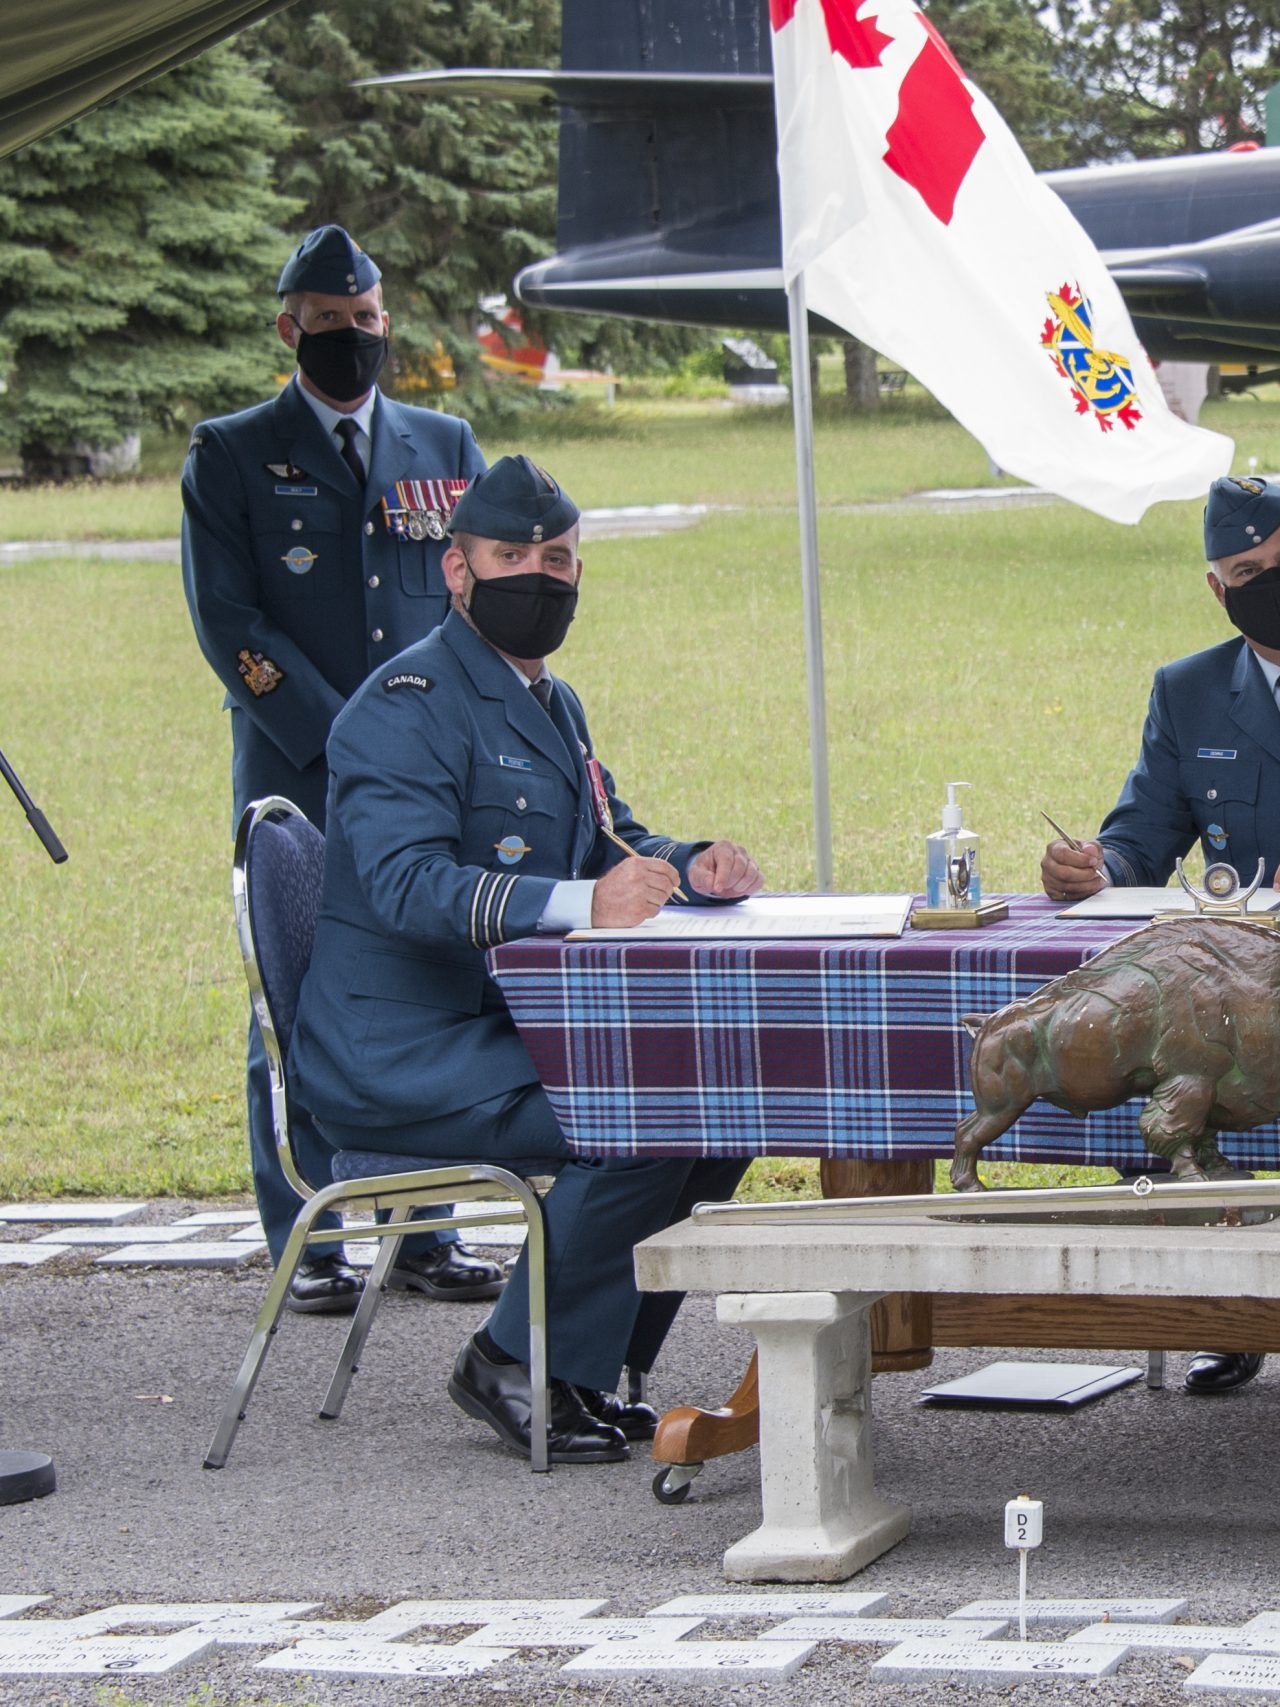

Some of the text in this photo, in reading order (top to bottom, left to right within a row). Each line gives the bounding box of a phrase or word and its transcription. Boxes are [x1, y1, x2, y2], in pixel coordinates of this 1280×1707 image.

[387, 675, 427, 688] CANADA
[1017, 1513, 1027, 1526] D
[1018, 1528, 1027, 1540] 2
